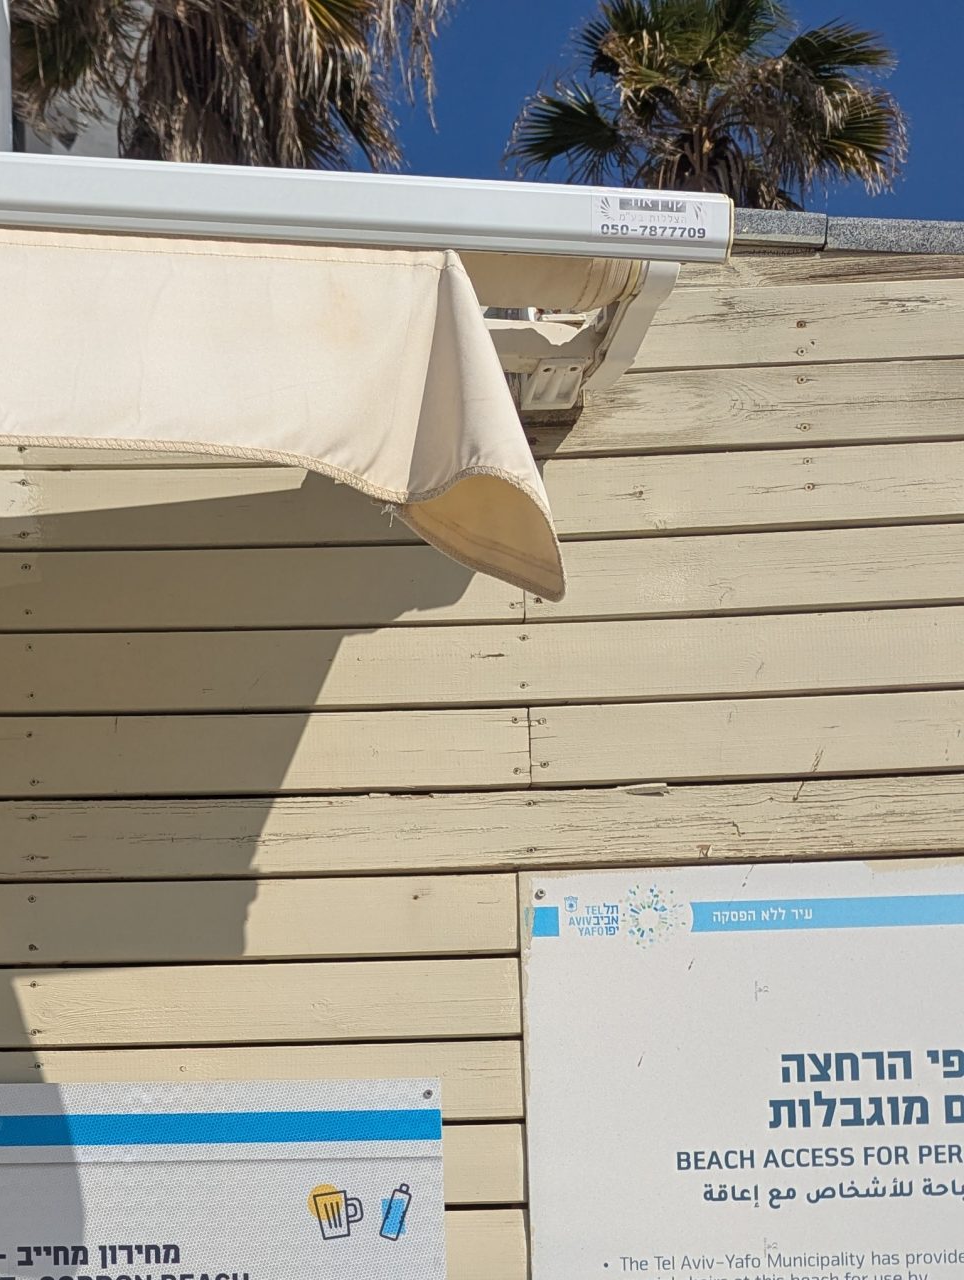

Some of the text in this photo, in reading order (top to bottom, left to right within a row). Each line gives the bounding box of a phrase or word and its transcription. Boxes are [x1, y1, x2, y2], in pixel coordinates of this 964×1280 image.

[601, 223, 706, 239] 050-7877709
[585, 905, 604, 915] TEL
[603, 902, 619, 915] תל
[712, 907, 813, 924] עיר ללא הפסקה
[569, 916, 592, 926] AVIV
[592, 915, 618, 925] אביב
[578, 926, 604, 936] YAFO
[605, 926, 619, 935] יפו
[781, 1050, 912, 1083] הרחצה
[769, 1090, 929, 1128] מוגבלות
[676, 1145, 910, 1171] BEACH ACCESS FOR
[17, 1244, 89, 1267] מחייב
[98, 1243, 181, 1268] מחירון
[620, 1256, 649, 1271] The
[654, 1255, 676, 1271] Tel
[766, 1251, 864, 1270] Municipality
[870, 1251, 900, 1266] has
